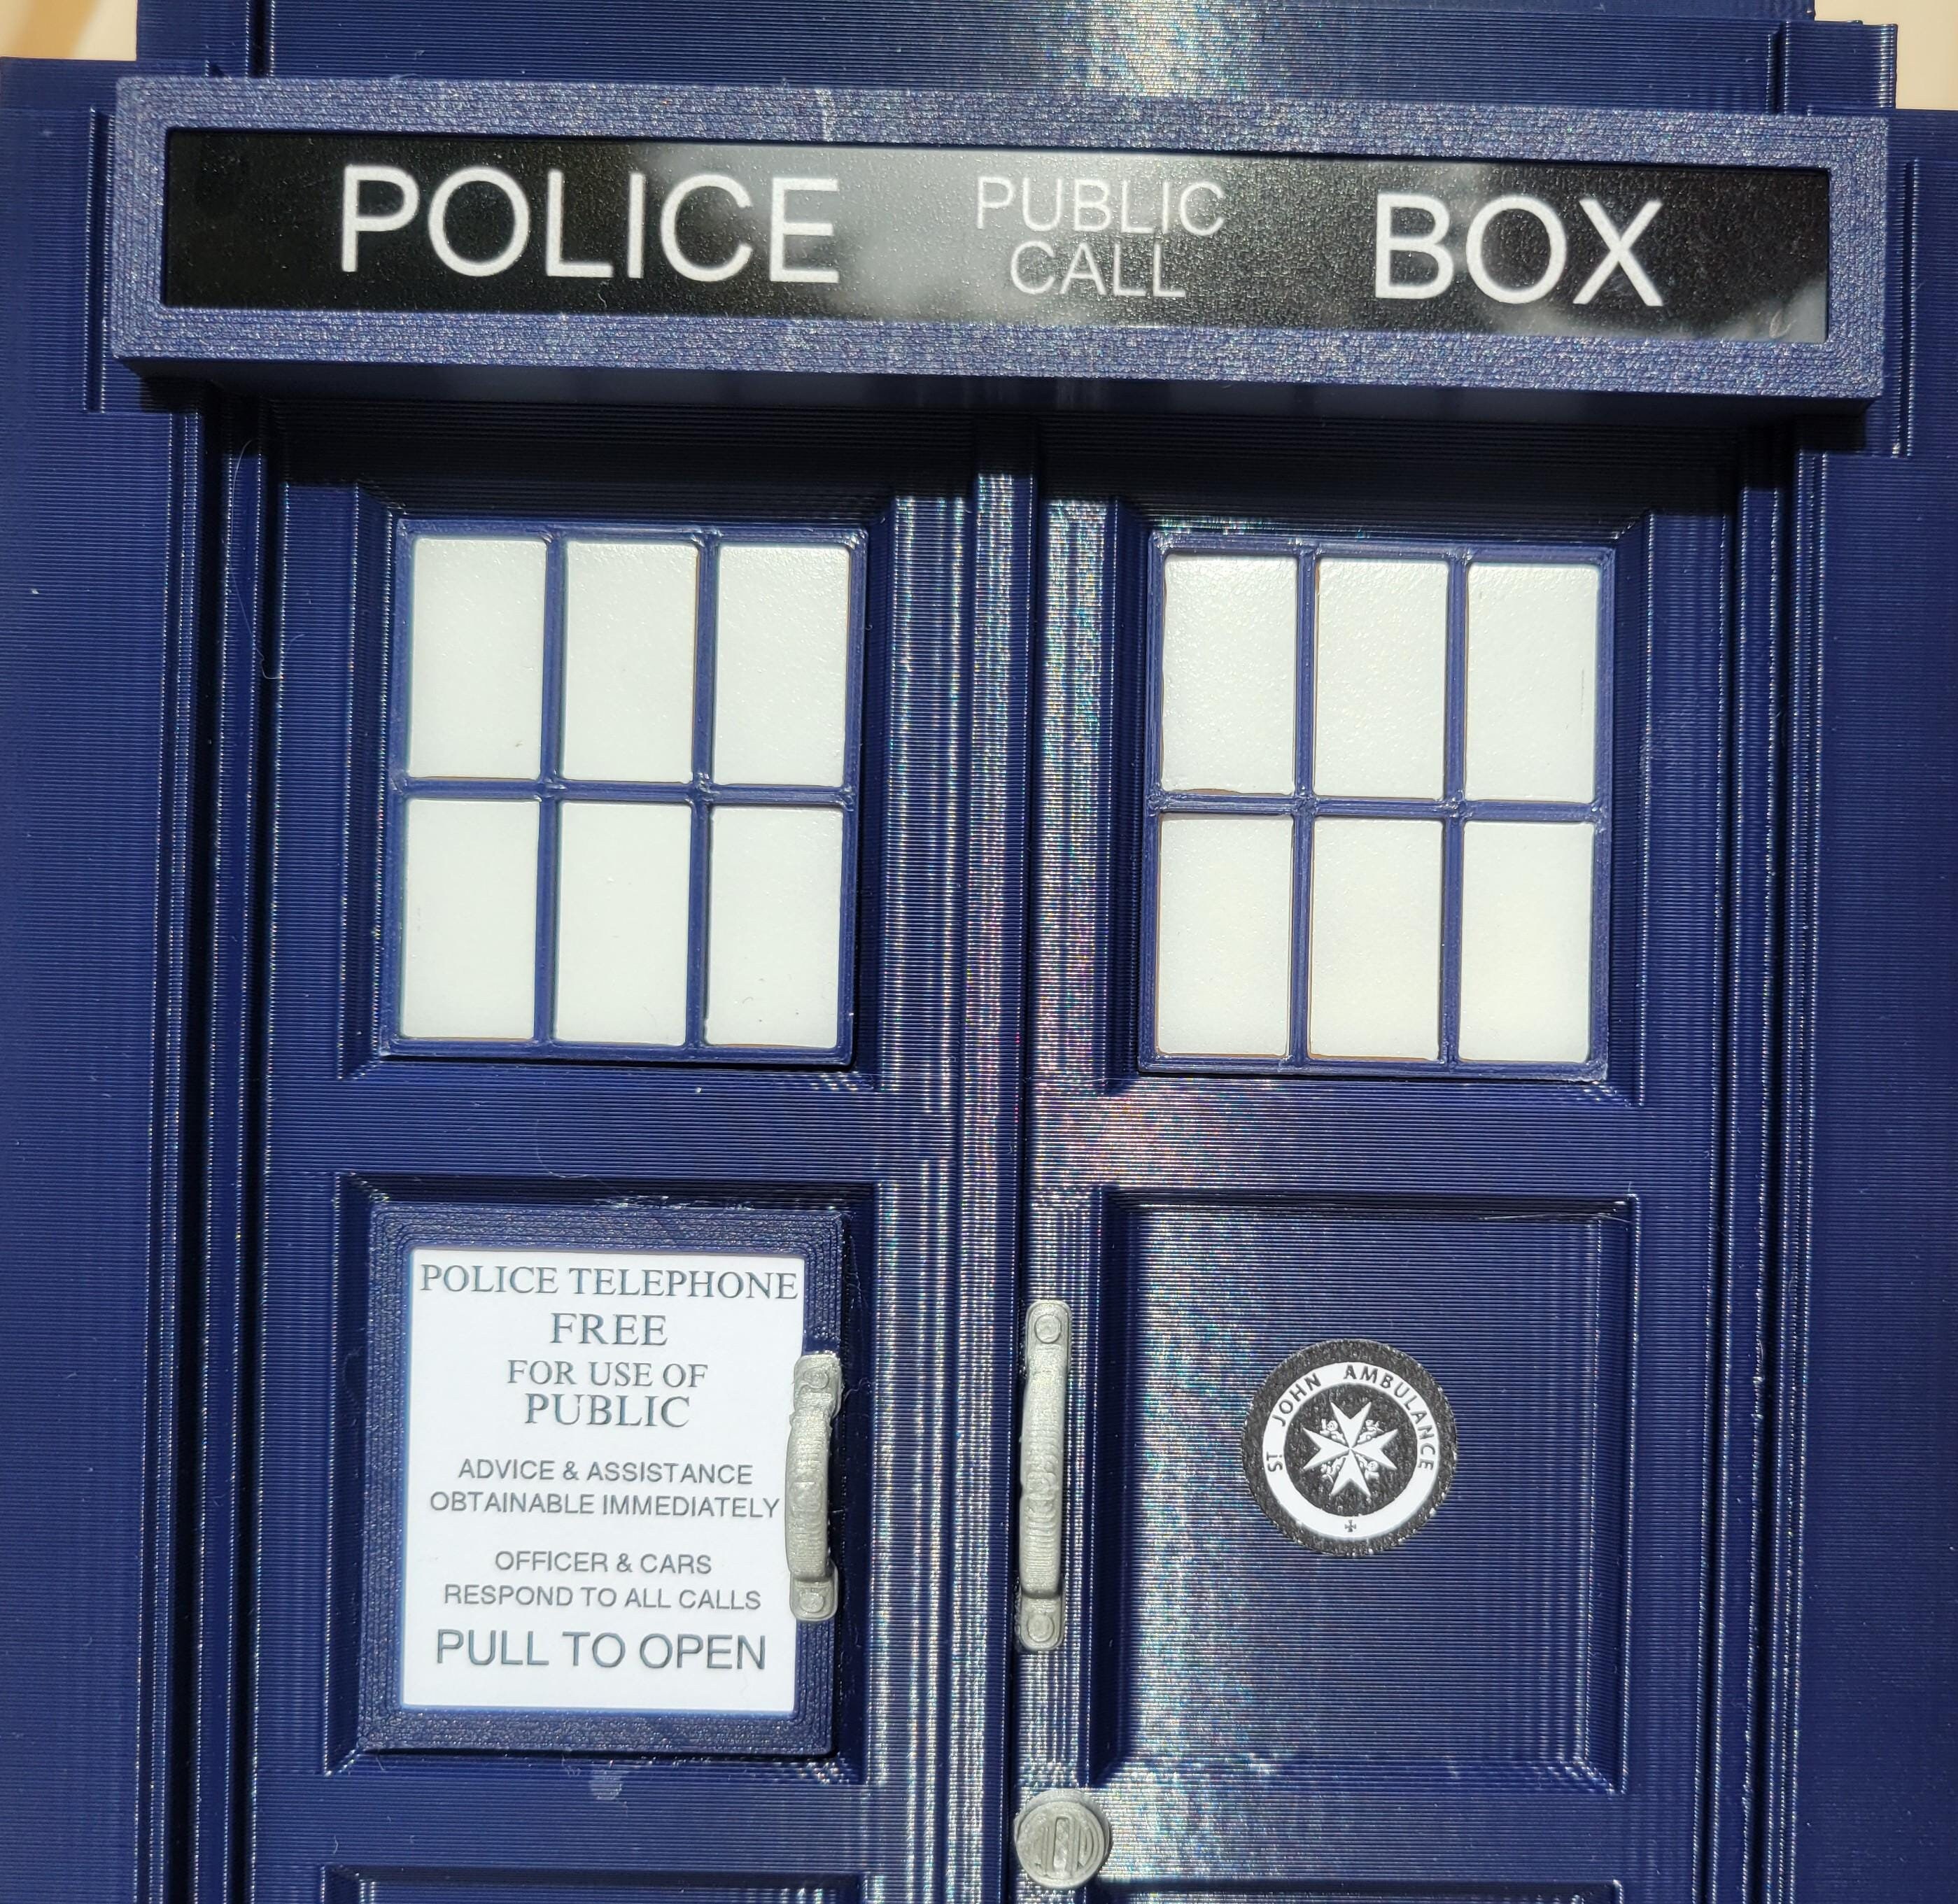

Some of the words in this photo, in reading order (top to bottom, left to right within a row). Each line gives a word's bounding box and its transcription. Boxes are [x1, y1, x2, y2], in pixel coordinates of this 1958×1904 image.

[340, 164, 840, 283] POLICE
[977, 176, 1225, 236] PUBLIC
[1373, 192, 1663, 306] BOX
[1010, 241, 1187, 297] CALL
[420, 1264, 558, 1293] POLICE
[569, 1267, 798, 1299] TELEPHONE
[549, 1313, 668, 1346] FREE
[507, 1360, 577, 1385] FOR
[589, 1362, 653, 1387] USE
[662, 1363, 708, 1388] OF
[524, 1393, 690, 1428] PUBLIC
[1272, 1373, 1322, 1427] JOHN
[1344, 1364, 1436, 1471] AMBULANCE
[458, 1458, 555, 1480] ADVICE
[563, 1460, 579, 1481] &
[586, 1461, 753, 1485] ASSISTANCE
[430, 1491, 595, 1514] OBTAINABLE
[603, 1494, 780, 1518] IMMEDIATELY
[495, 1551, 608, 1572] OFFICER
[616, 1553, 633, 1573] &
[640, 1553, 712, 1574] CARS
[444, 1584, 573, 1607] RESPOND
[580, 1587, 617, 1607] TO
[624, 1588, 671, 1609] ALL
[679, 1589, 761, 1610] CALLS
[436, 1629, 549, 1666] PULL
[562, 1631, 626, 1668] TO
[639, 1633, 766, 1670] OPEN
